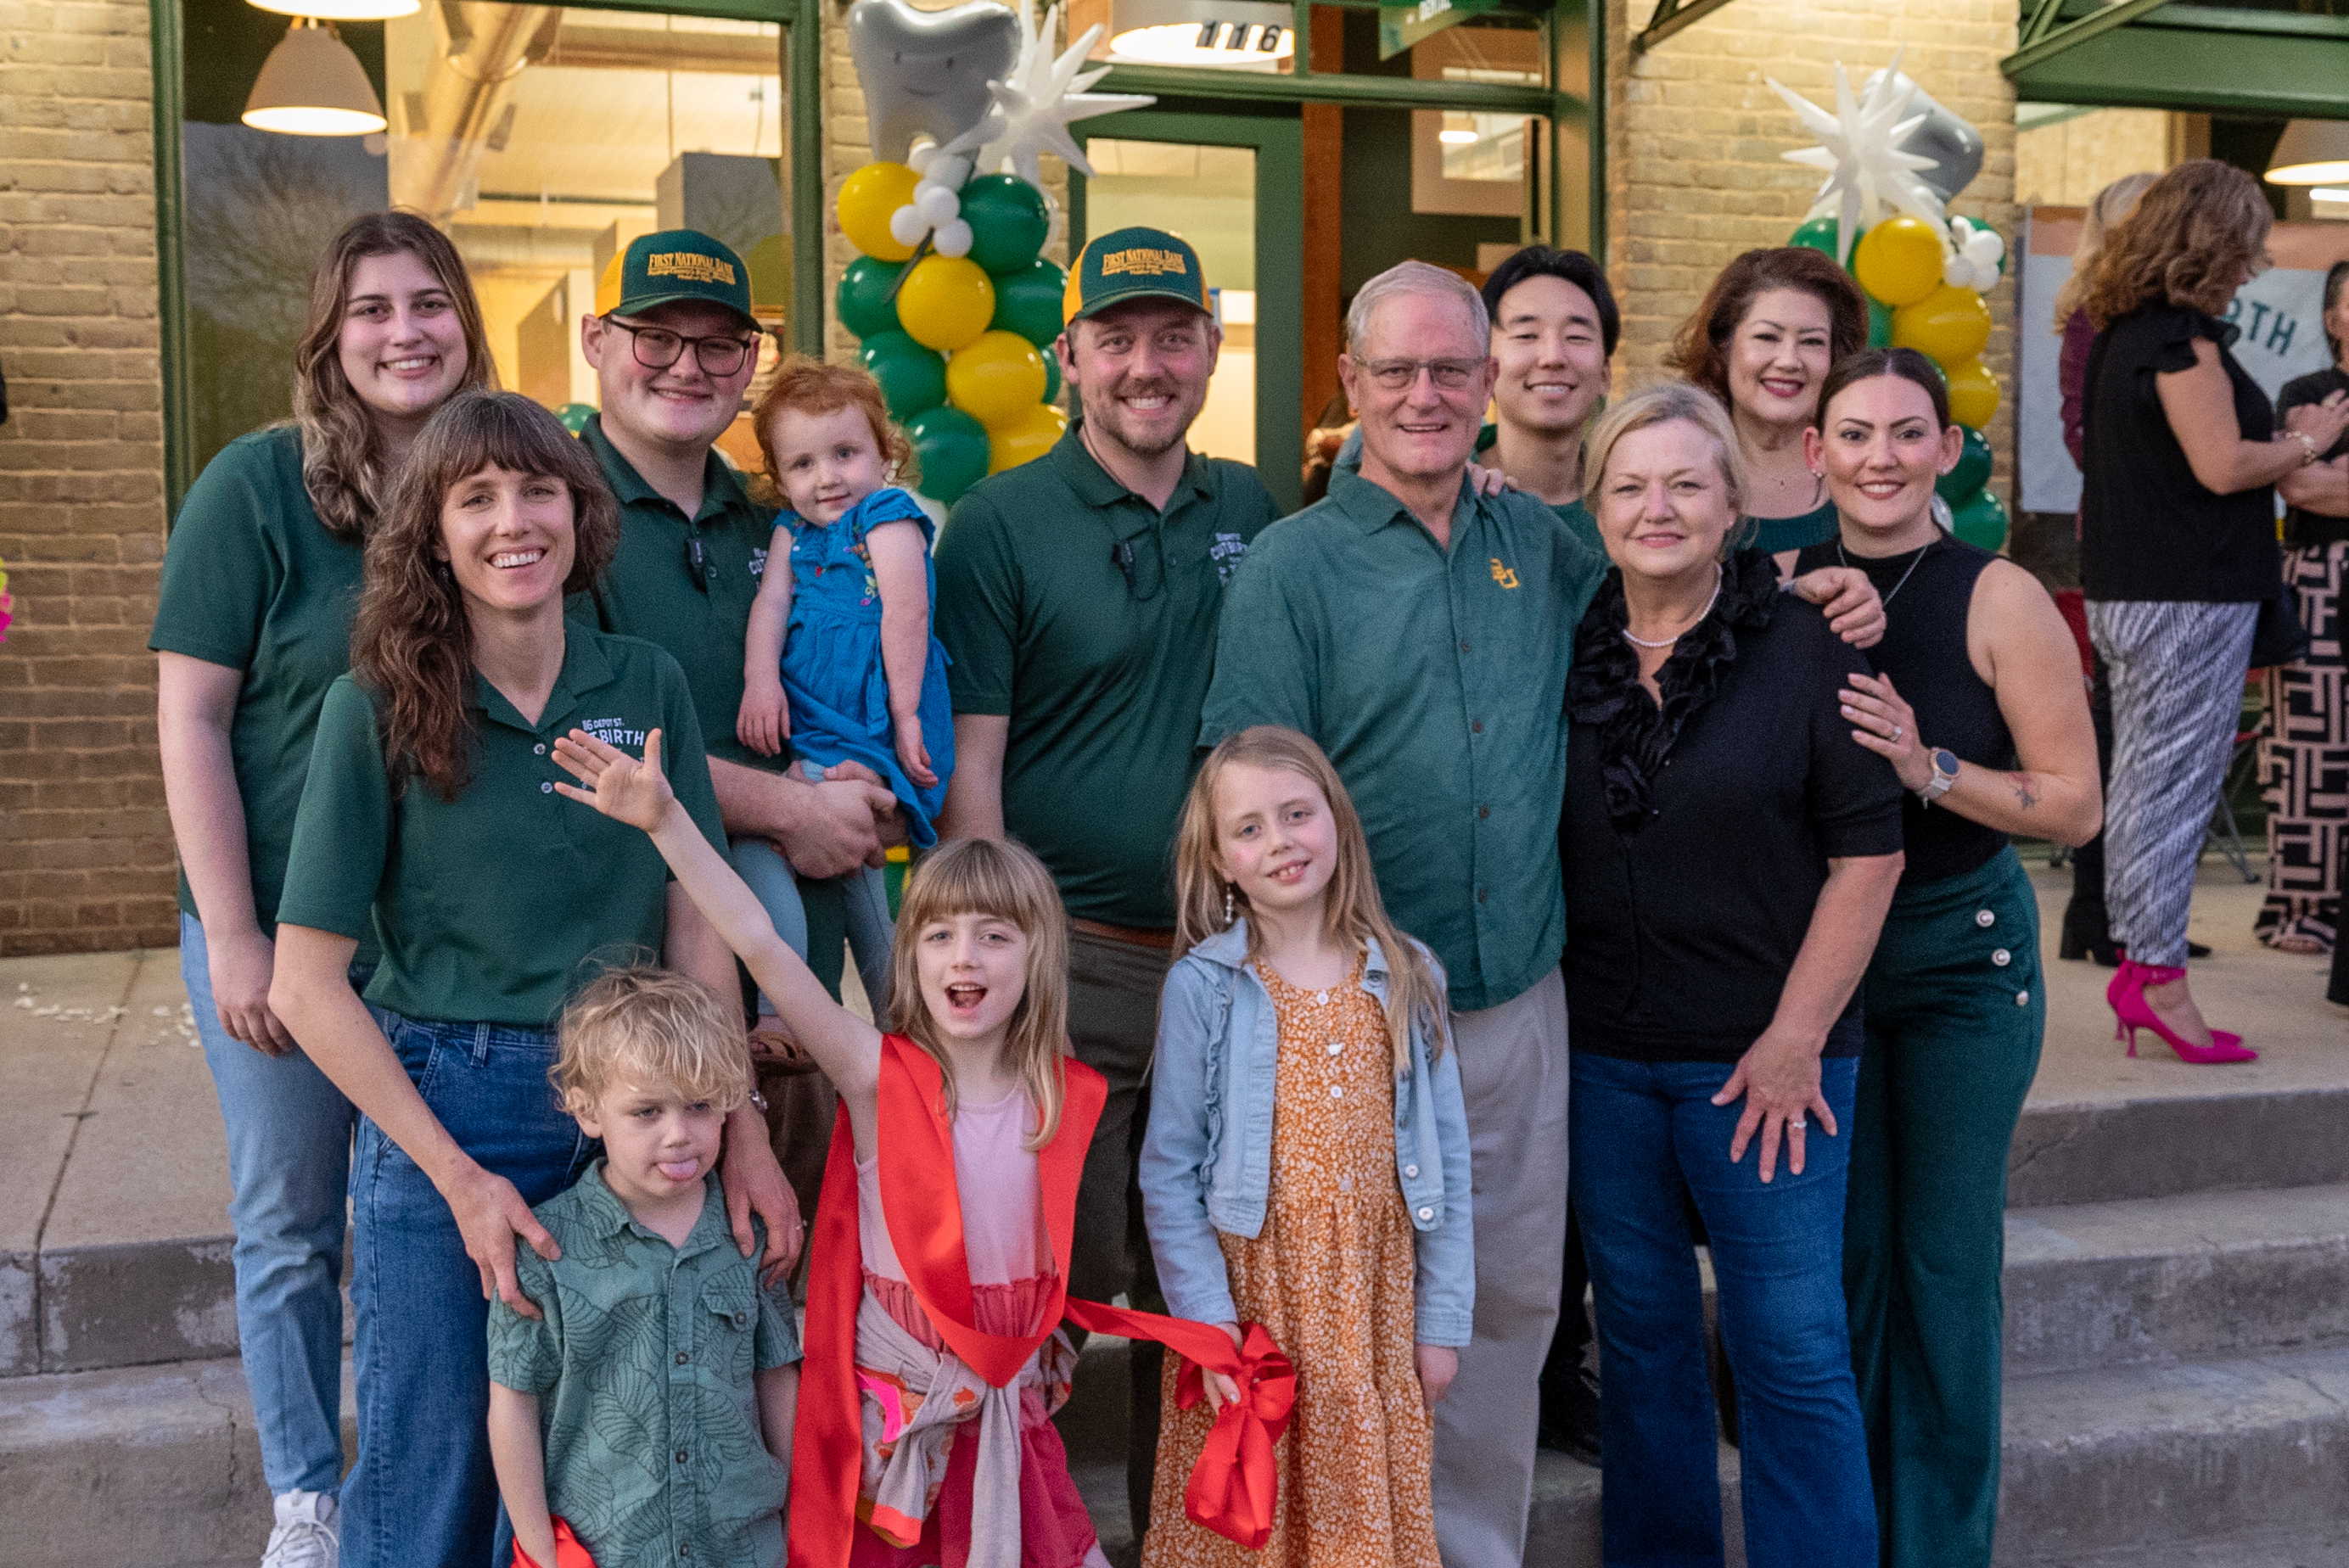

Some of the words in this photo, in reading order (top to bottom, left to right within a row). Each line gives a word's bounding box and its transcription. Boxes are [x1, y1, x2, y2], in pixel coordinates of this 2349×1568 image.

[1203, 20, 1281, 53] 116
[648, 254, 674, 267] FIRST
[675, 251, 714, 267] NATIONAL
[1102, 251, 1125, 269] FIRST
[1126, 248, 1163, 263] NATIONAL
[588, 728, 645, 747] BIRTH
